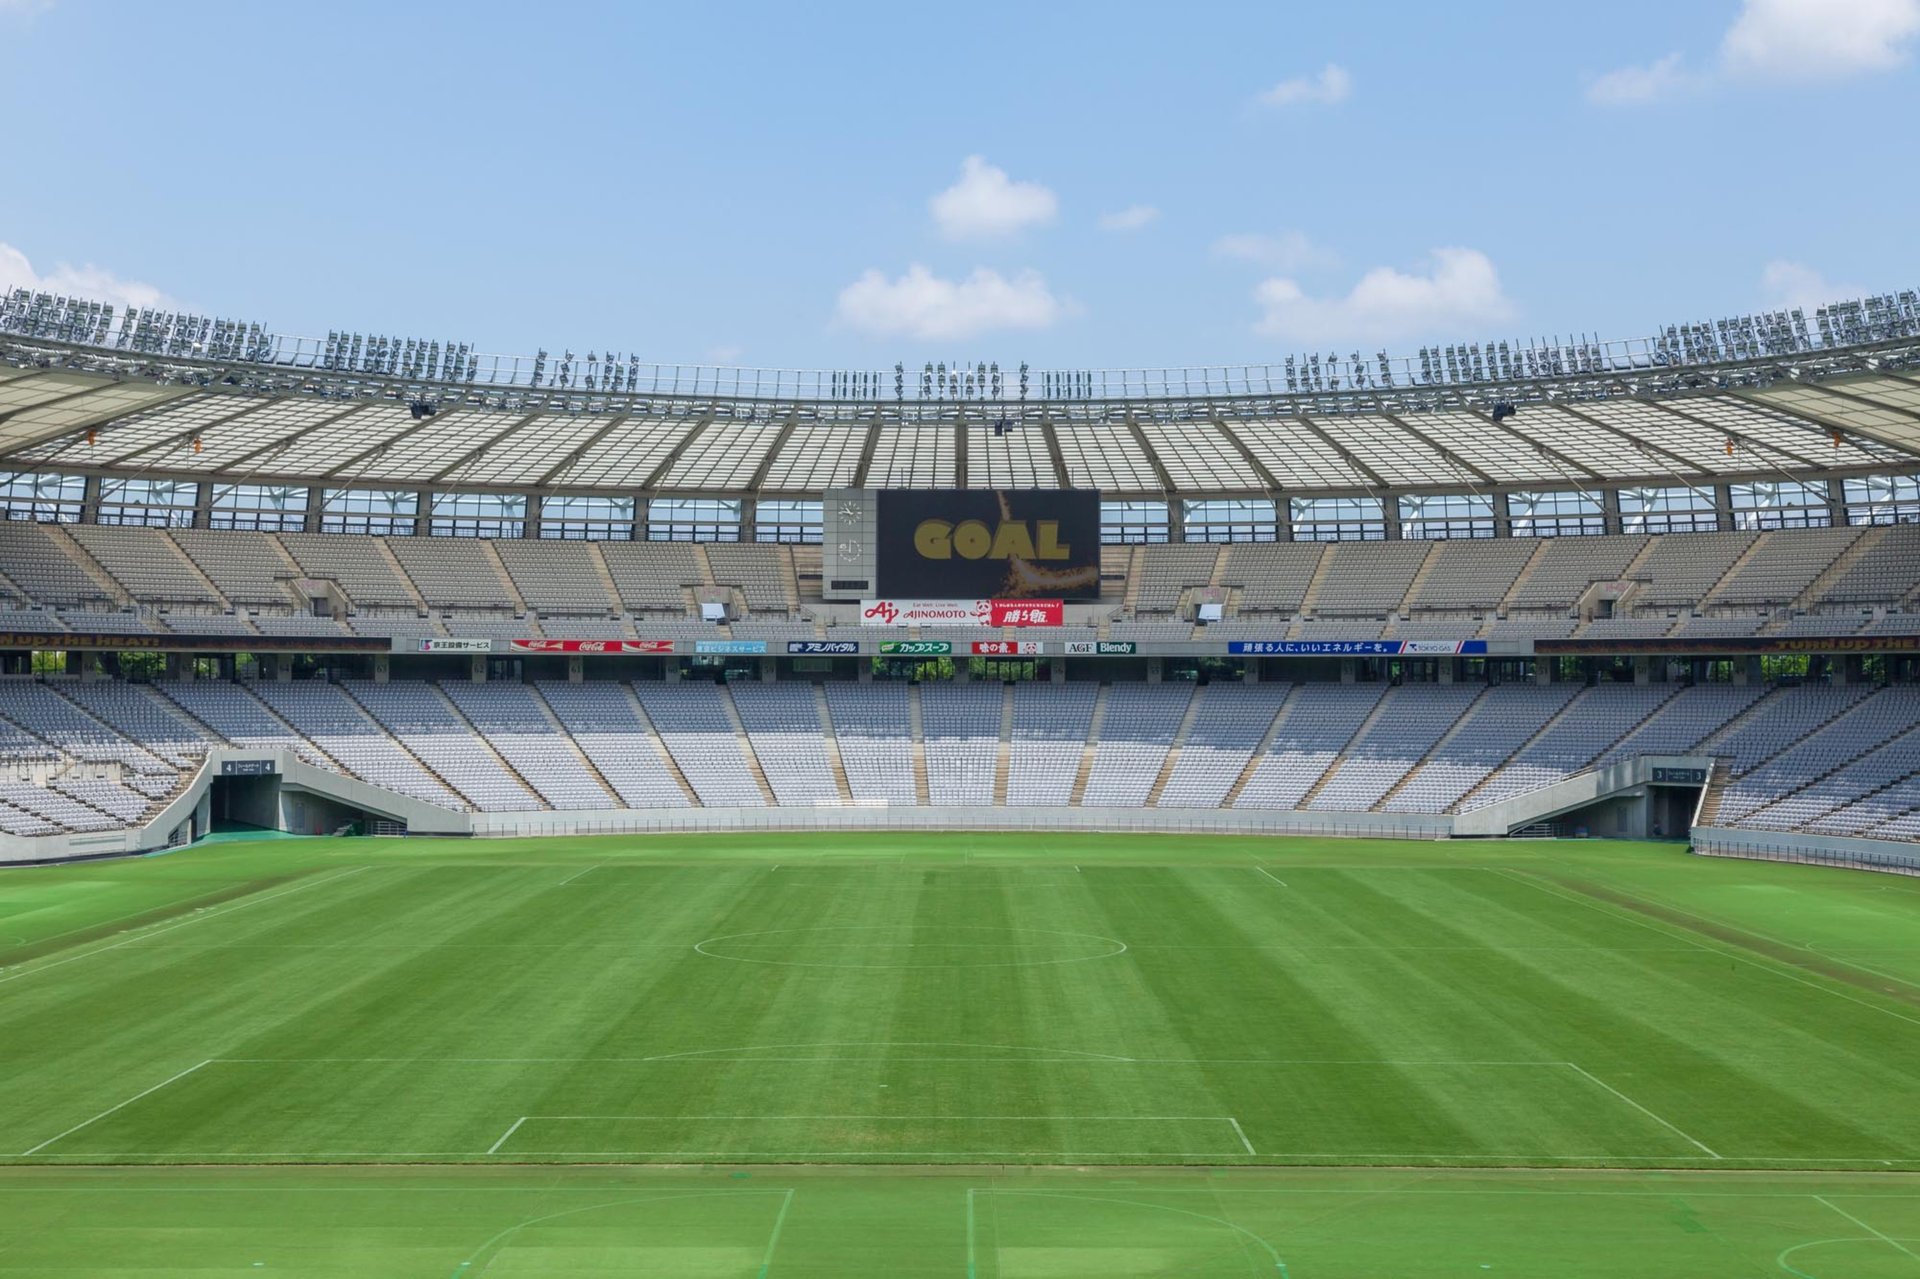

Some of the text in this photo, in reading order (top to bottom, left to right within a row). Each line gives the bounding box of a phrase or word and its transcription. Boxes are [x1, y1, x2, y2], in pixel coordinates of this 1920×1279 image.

[914, 519, 1070, 560] GOAL
[903, 610, 966, 619] AJINOMOTO
[805, 643, 856, 652] アミノバイタル
[899, 643, 949, 652] カップスープ
[1068, 642, 1093, 653] AGF
[1100, 642, 1133, 654] Blendy
[1242, 643, 1388, 653] 頑張る人に、いいエネルギーを。
[226, 763, 232, 772] 4
[265, 762, 271, 772] 4
[1656, 770, 1663, 779] 3
[1695, 771, 1702, 780] 3
